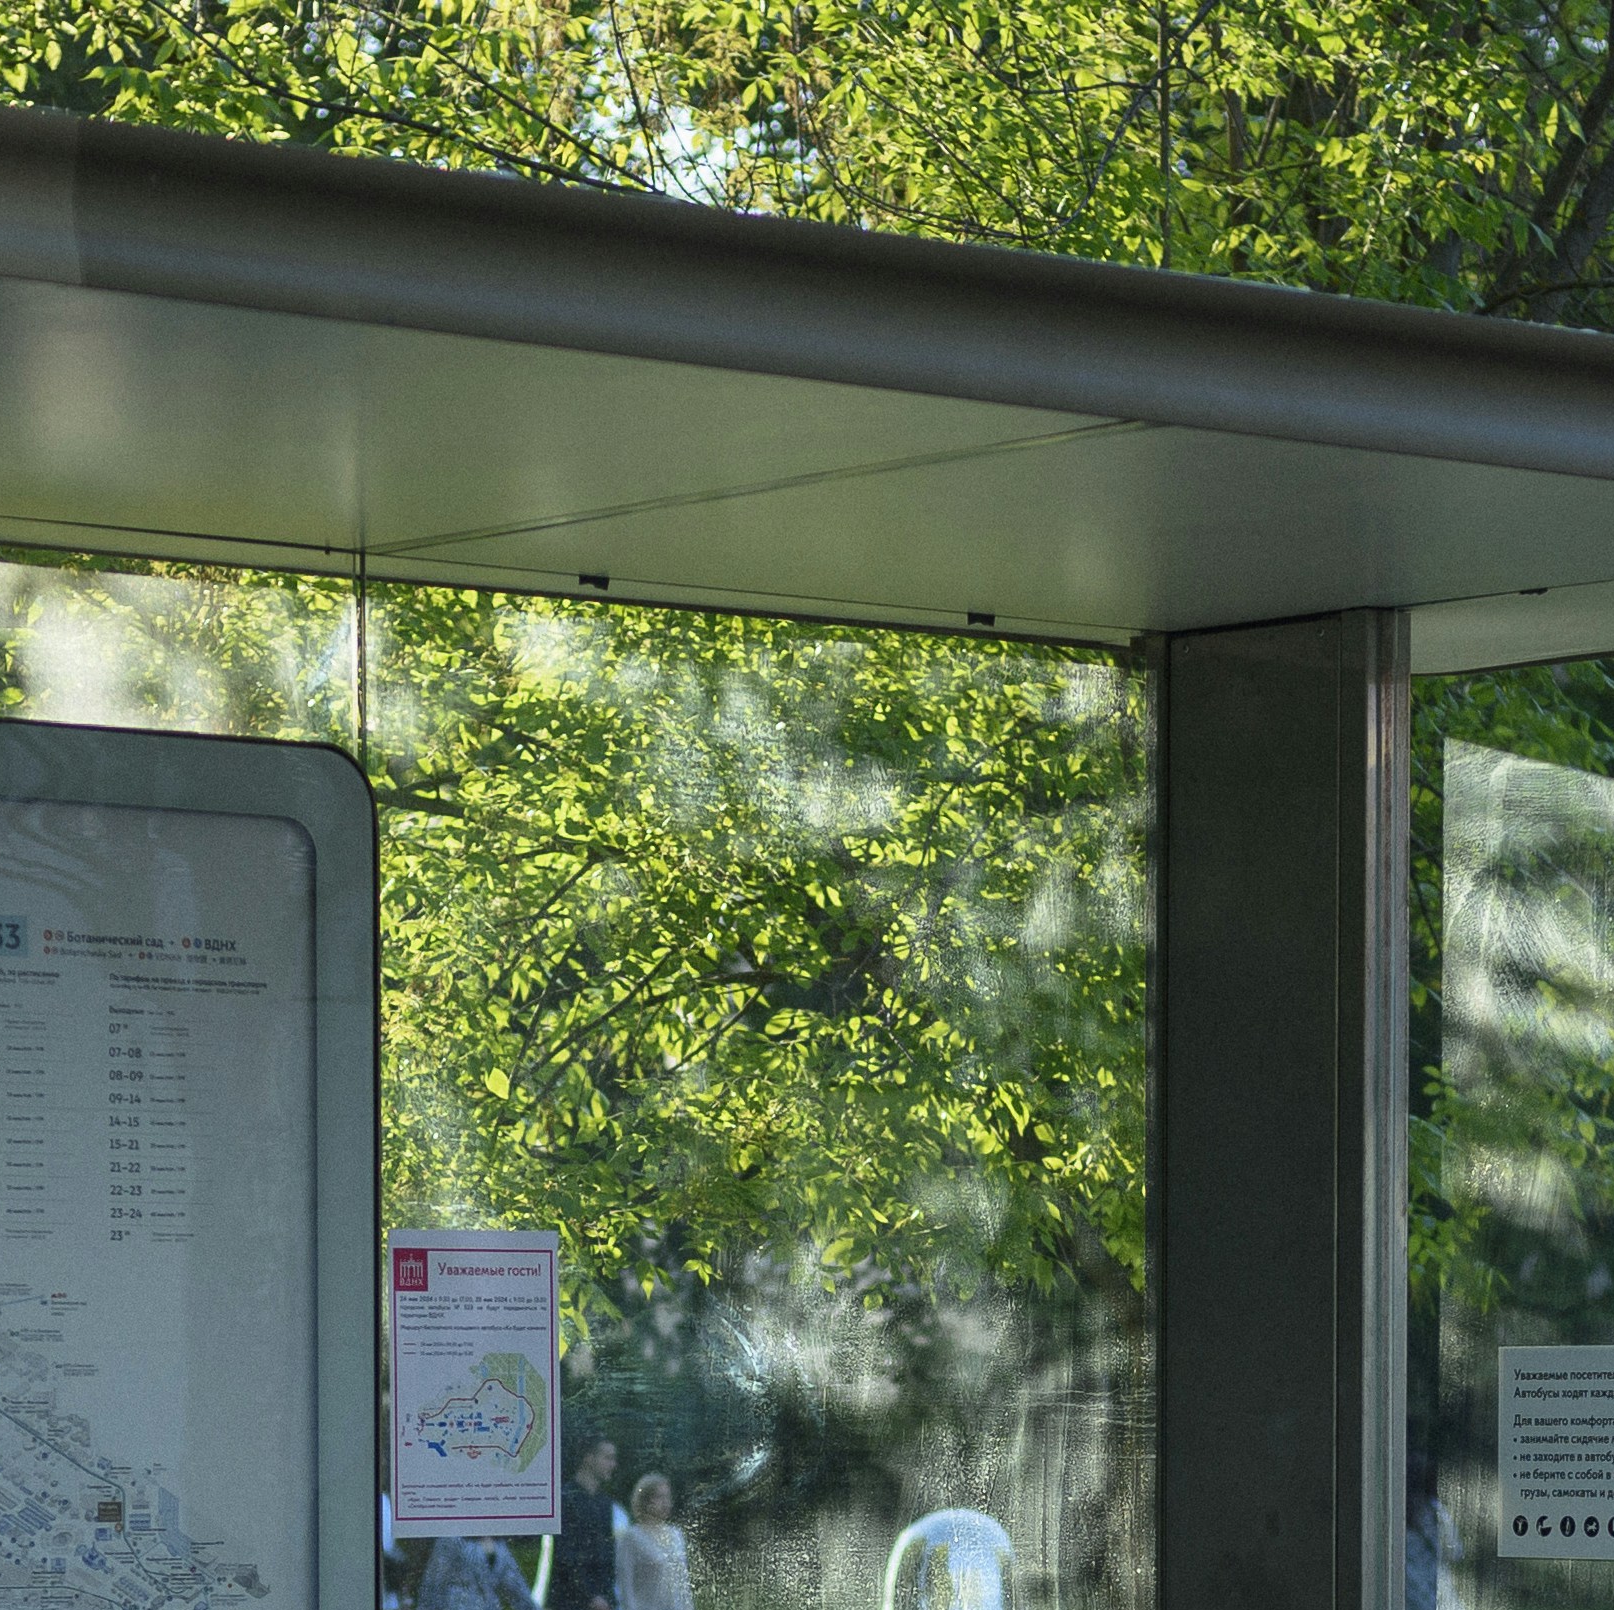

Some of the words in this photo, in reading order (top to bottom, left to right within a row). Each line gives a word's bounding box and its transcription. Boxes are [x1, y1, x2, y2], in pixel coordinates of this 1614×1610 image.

[68, 932, 143, 946] Ботанический
[145, 938, 164, 949] сад
[205, 939, 236, 952] ВДНХ
[438, 1262, 504, 1276] Уважаемые
[508, 1264, 541, 1276] гости!
[399, 1278, 423, 1286] ВДНХ
[1514, 1369, 1568, 1380] Уважаемые
[1514, 1387, 1559, 1401] Автобусы
[1562, 1390, 1588, 1399] ходят
[1513, 1414, 1532, 1427] Для
[1535, 1418, 1568, 1426] вашего
[1521, 1434, 1569, 1443] занимайте
[1571, 1436, 1609, 1445] сидячие
[1533, 1454, 1575, 1462] заходите
[1520, 1471, 1531, 1479] не
[1533, 1469, 1565, 1481] берите
[1575, 1469, 1603, 1480] собой
[1606, 1472, 1611, 1480] в
[1521, 1489, 1550, 1499] грузы,
